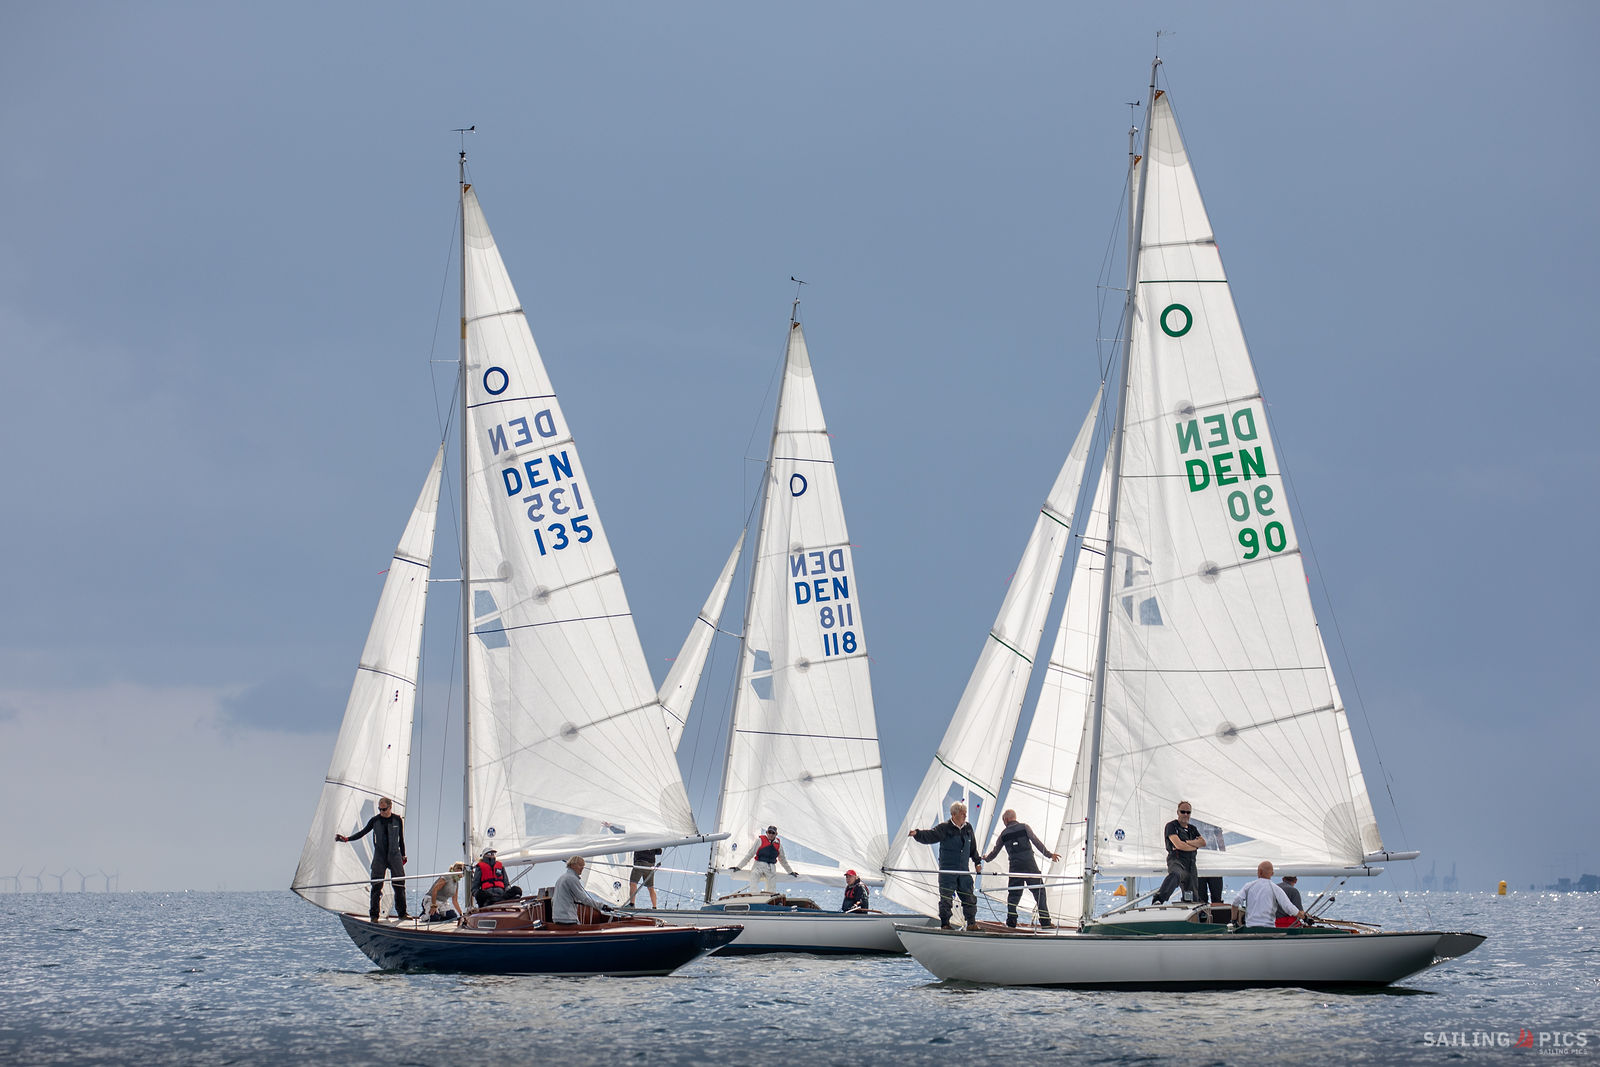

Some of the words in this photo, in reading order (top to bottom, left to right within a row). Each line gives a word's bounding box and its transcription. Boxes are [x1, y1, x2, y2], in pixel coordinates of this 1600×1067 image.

[501, 450, 574, 497] DEN
[1184, 446, 1267, 493] DEN
[533, 514, 594, 556] 135
[1238, 520, 1287, 560] 90
[794, 575, 849, 605] DEN
[823, 631, 858, 657] 118
